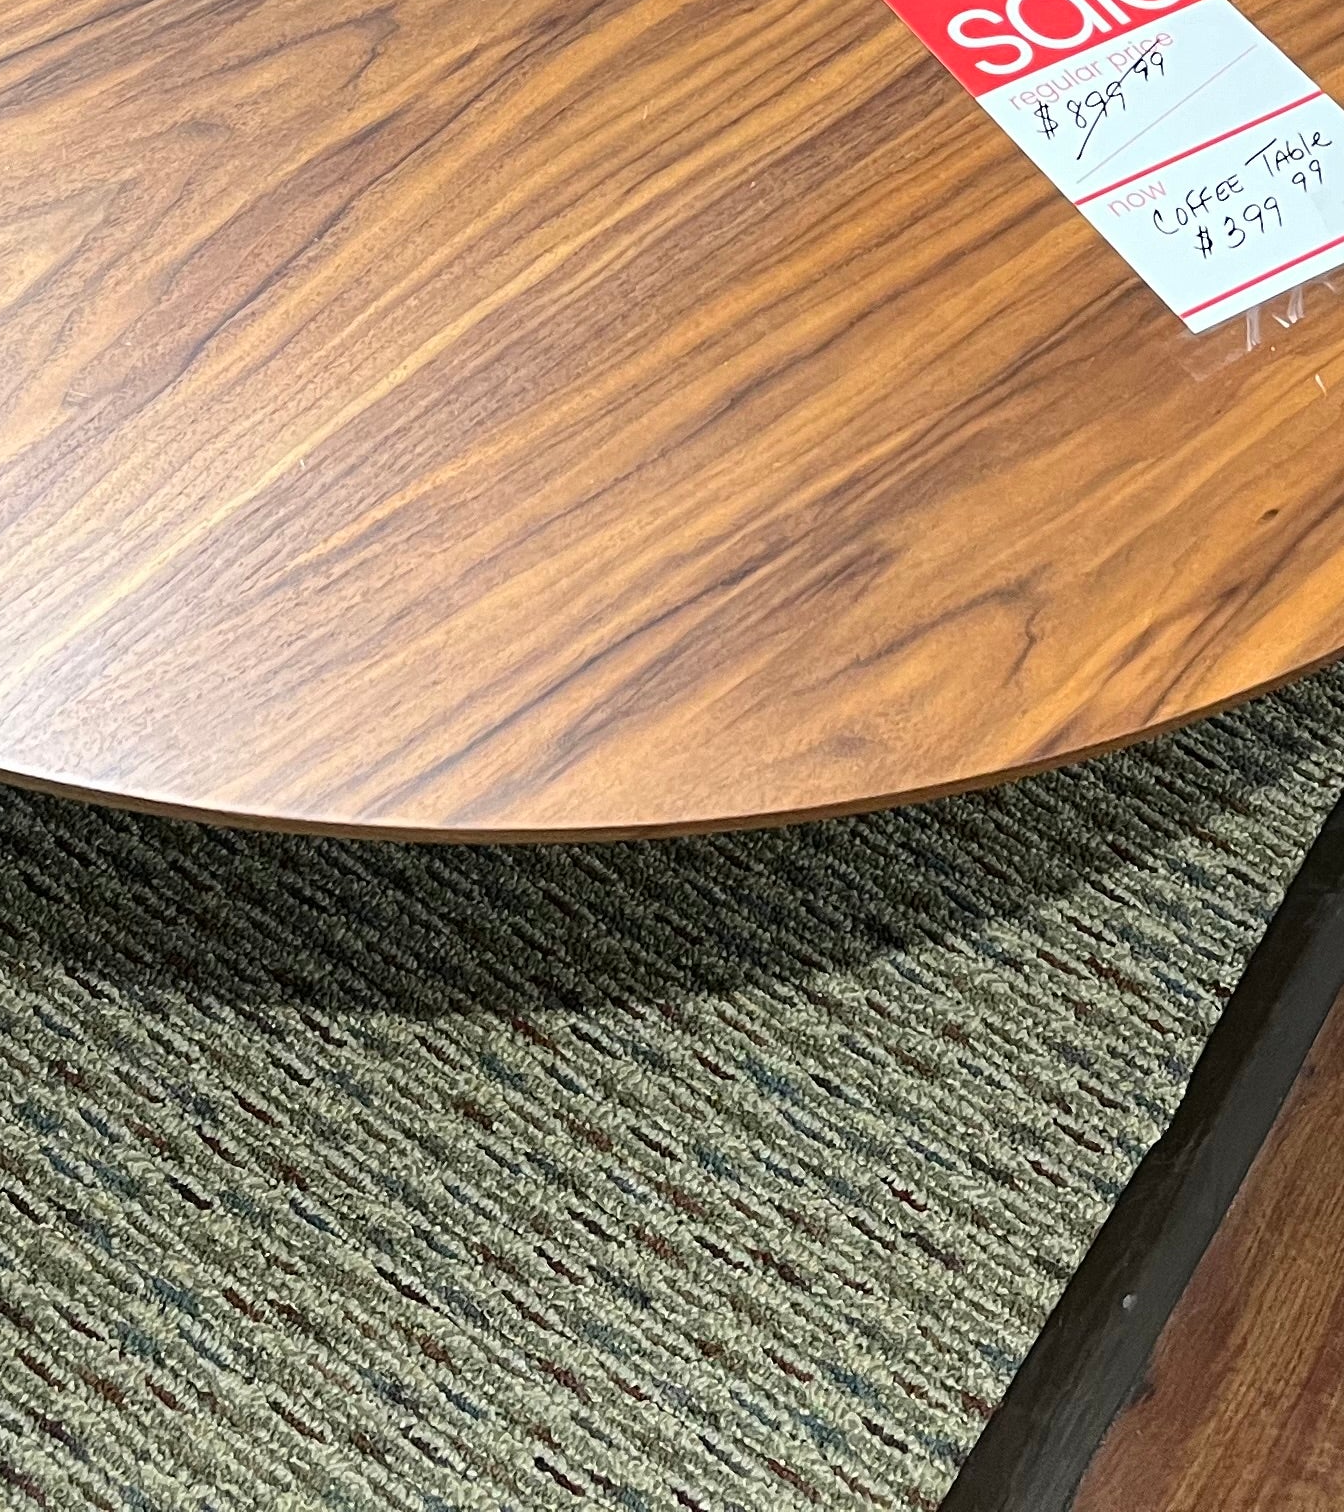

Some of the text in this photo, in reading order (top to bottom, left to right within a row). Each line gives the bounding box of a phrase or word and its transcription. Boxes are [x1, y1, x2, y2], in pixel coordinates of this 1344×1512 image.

[1008, 31, 1174, 112] regular price
[1106, 179, 1167, 218] now
